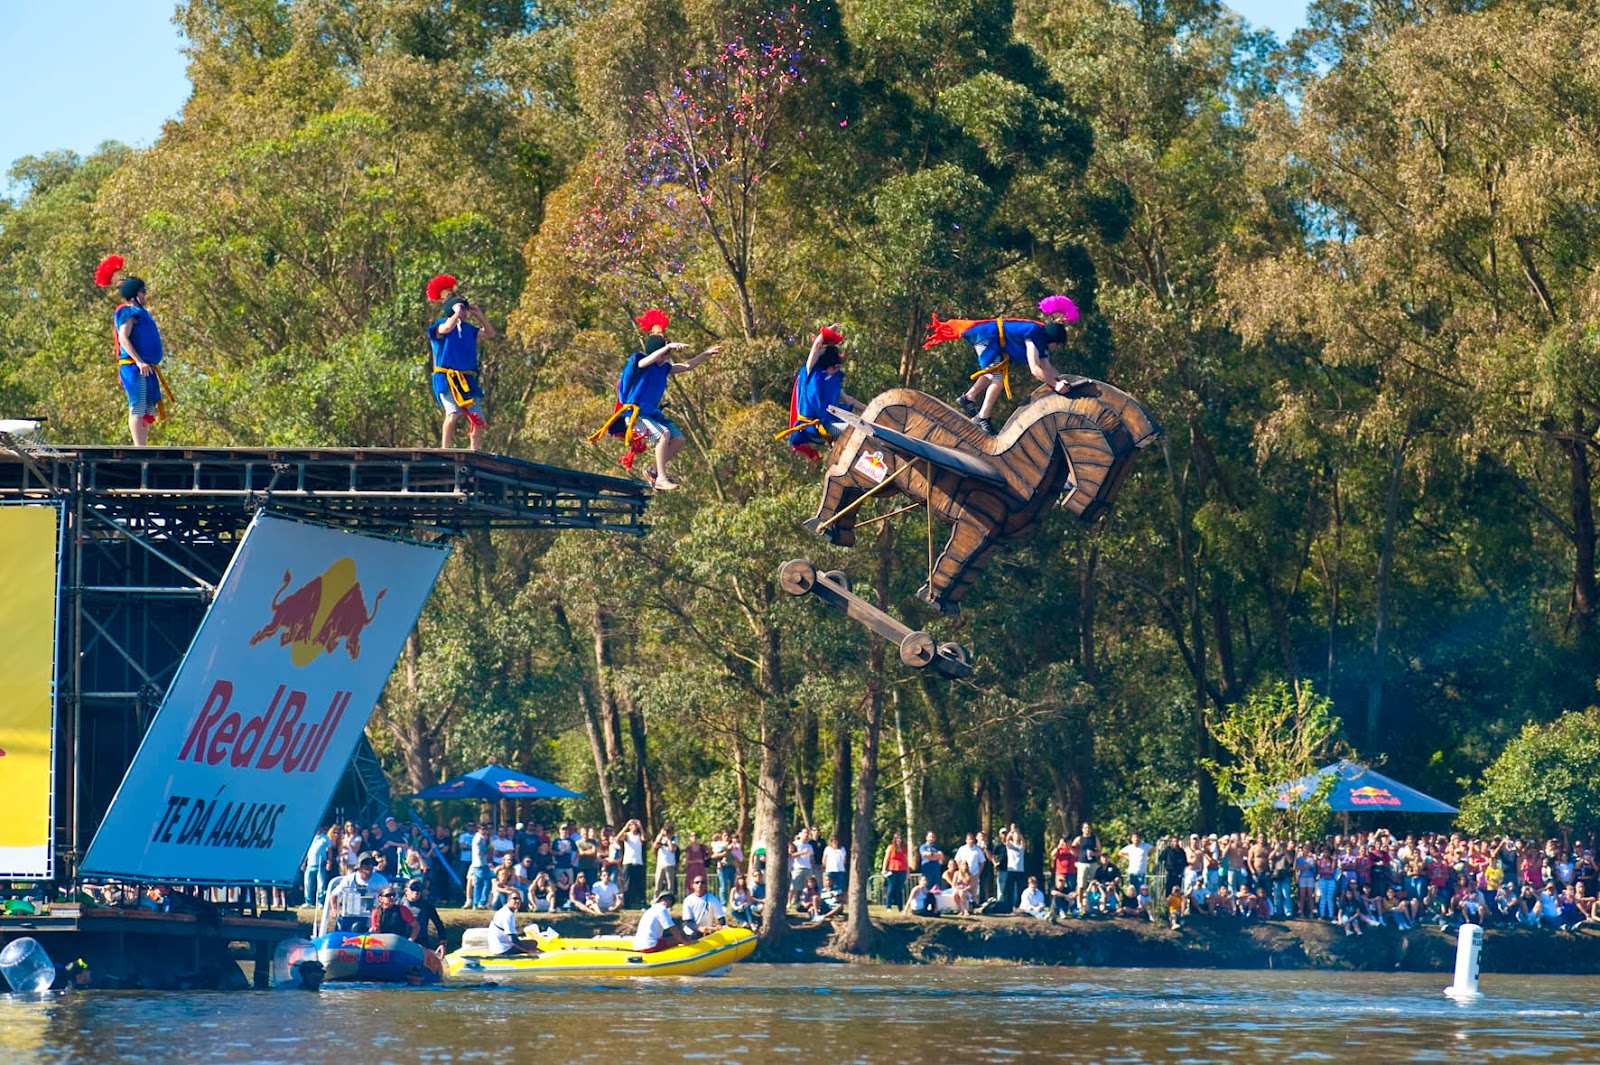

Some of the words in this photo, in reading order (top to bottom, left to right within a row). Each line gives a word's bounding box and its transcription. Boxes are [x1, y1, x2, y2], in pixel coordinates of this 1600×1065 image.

[178, 679, 287, 768] Red
[255, 690, 352, 773] Bull
[152, 795, 190, 843] TE
[176, 784, 226, 846] DÁ
